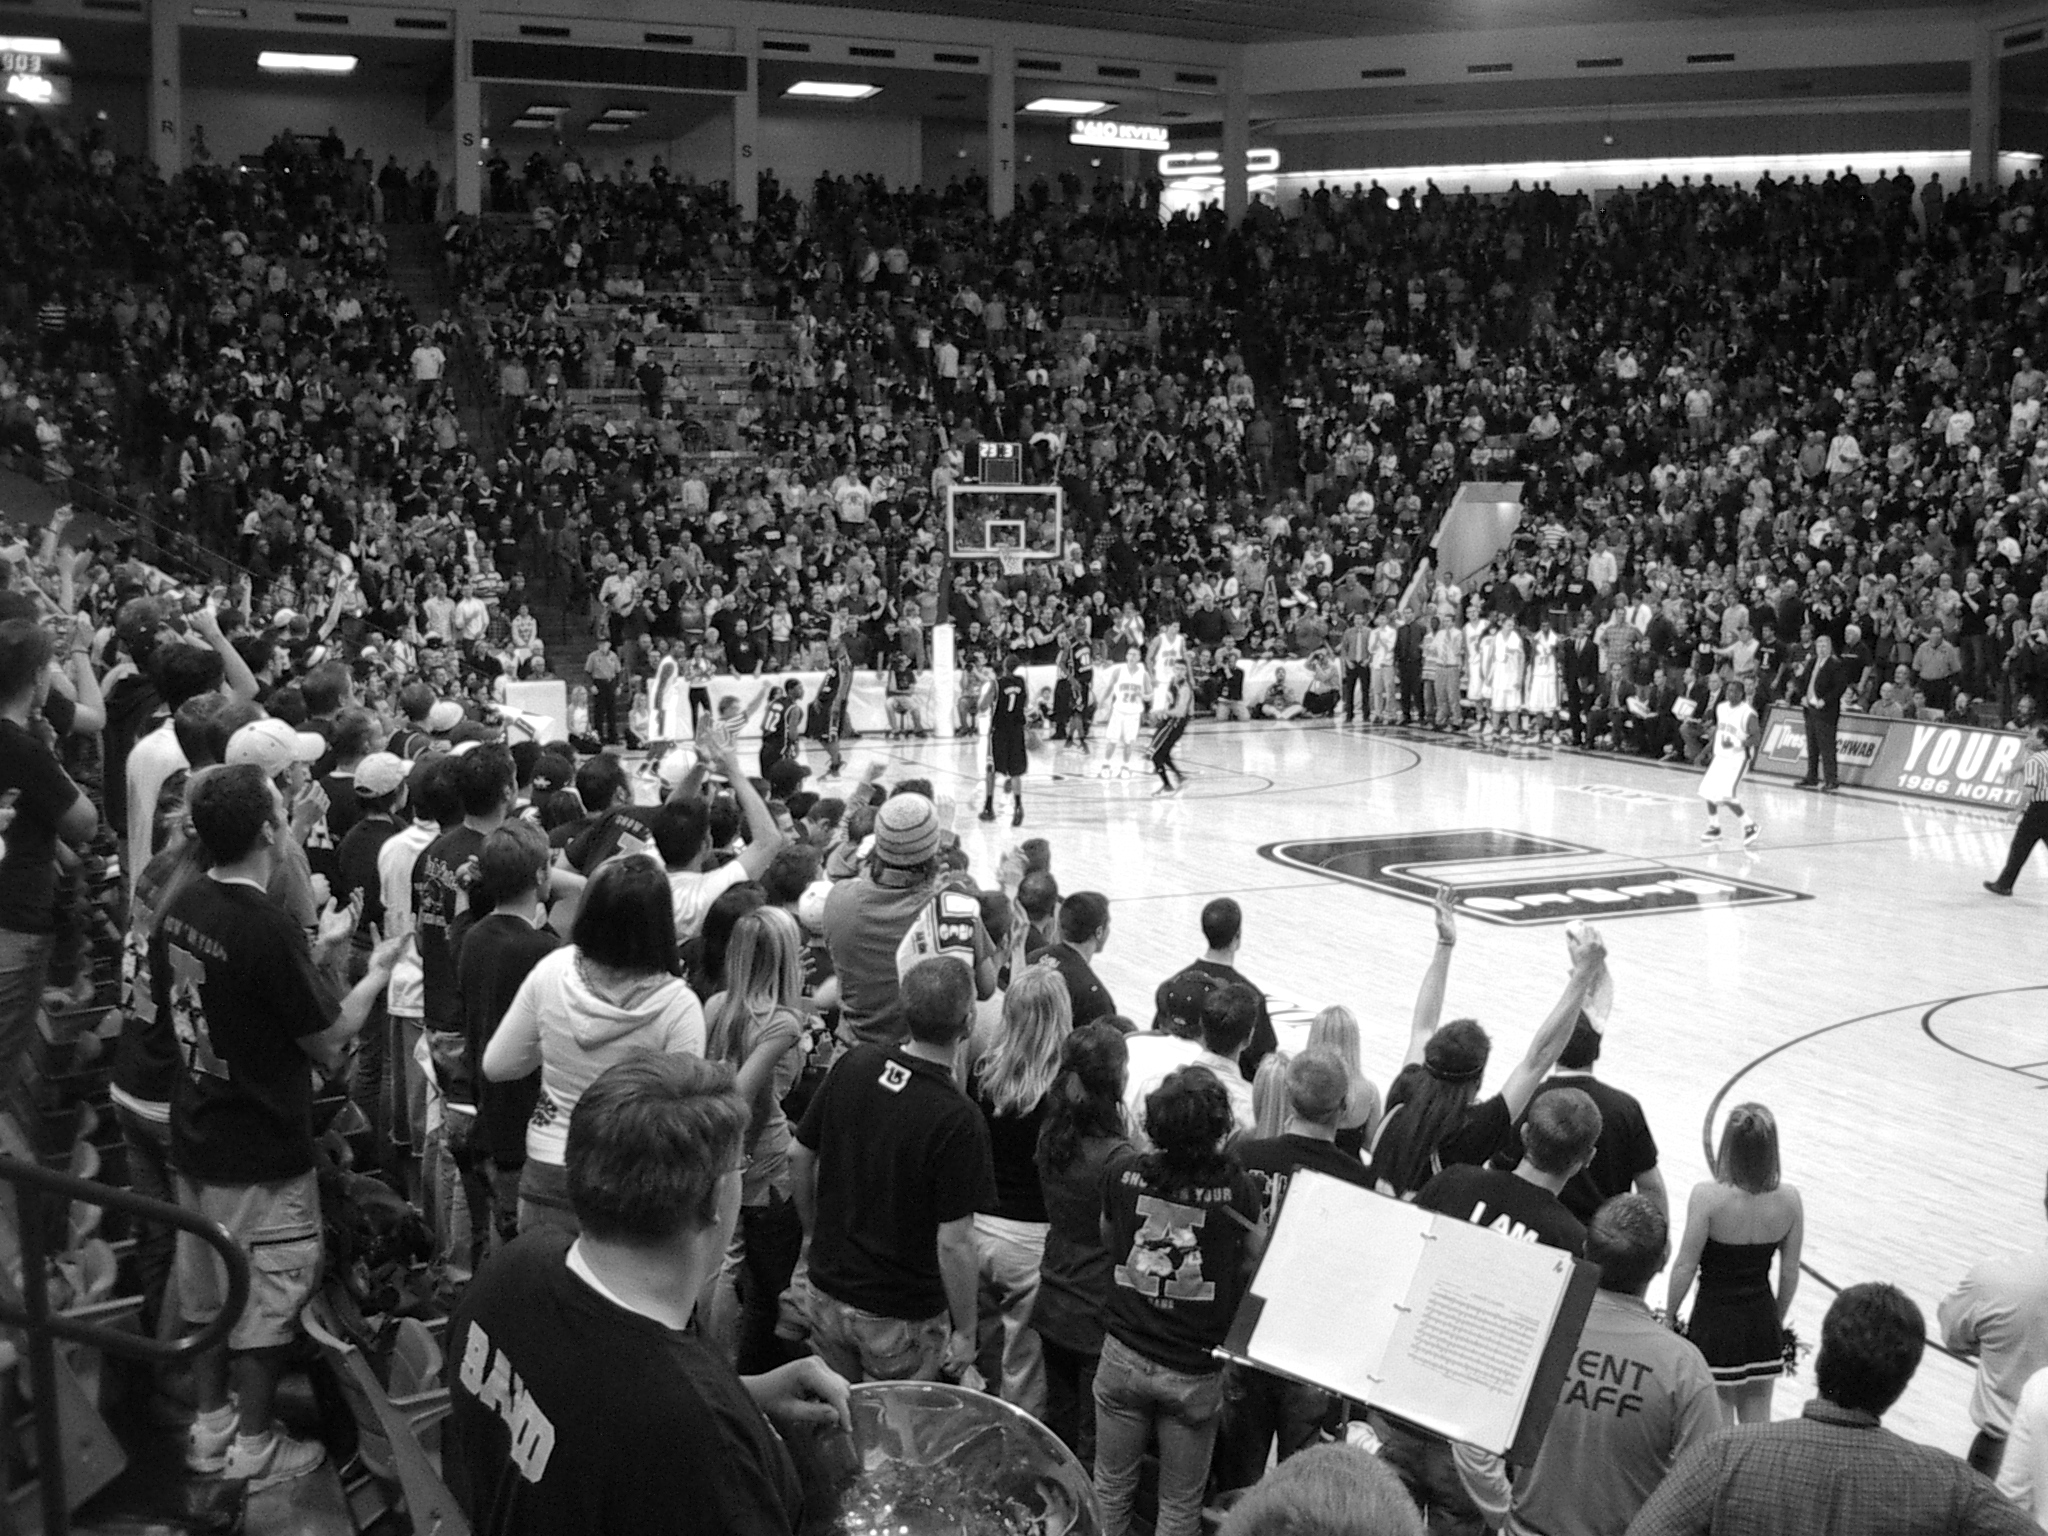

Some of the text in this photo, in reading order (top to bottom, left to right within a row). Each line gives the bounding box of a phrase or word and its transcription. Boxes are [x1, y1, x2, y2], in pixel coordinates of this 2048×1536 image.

[162, 121, 173, 133] R
[463, 133, 474, 147] S
[742, 145, 752, 158] S
[1000, 160, 1010, 171] T
[1008, 694, 1018, 713] 1
[1903, 725, 2022, 785] YOUR
[1898, 774, 1940, 794] 1986
